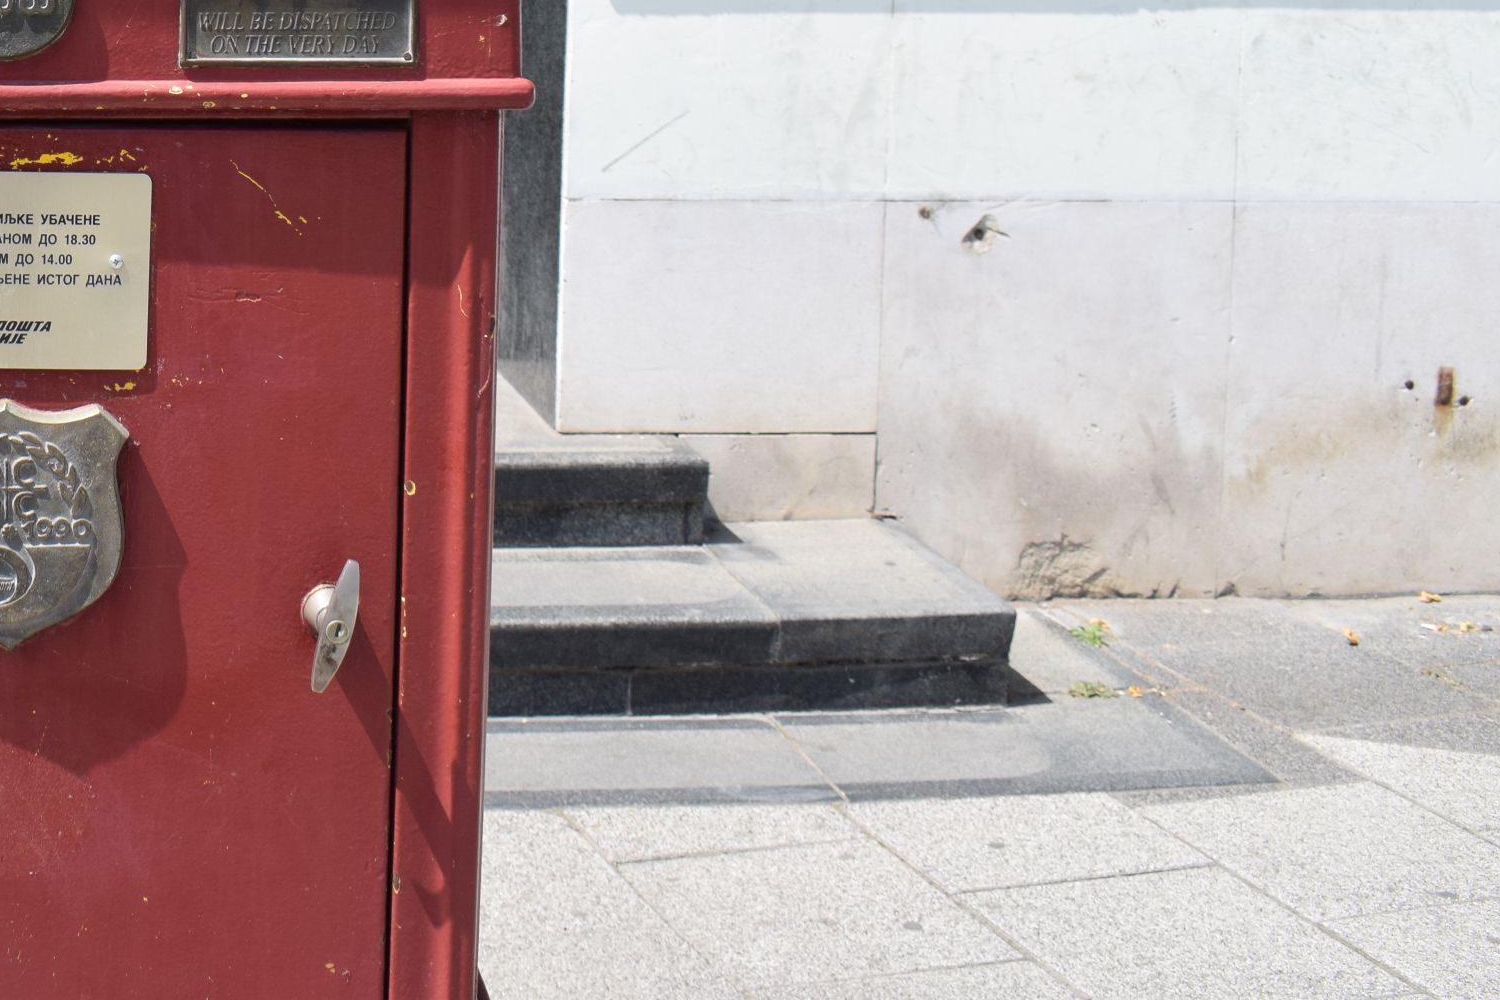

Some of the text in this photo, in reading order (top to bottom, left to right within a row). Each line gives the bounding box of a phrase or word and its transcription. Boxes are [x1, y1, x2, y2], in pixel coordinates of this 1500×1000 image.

[197, 11, 397, 32] WILL BE DISPATCHED
[210, 34, 381, 55] ON THE VERY DAY
[40, 214, 101, 226] УБАЧЕНЕ
[38, 233, 58, 247] ДО
[64, 234, 97, 246] 18.30
[14, 253, 34, 267] ДО
[41, 253, 73, 265] 14.00
[37, 274, 80, 286] ИСТОГ
[85, 274, 122, 287] ДАНА
[21, 516, 93, 541] 1990
